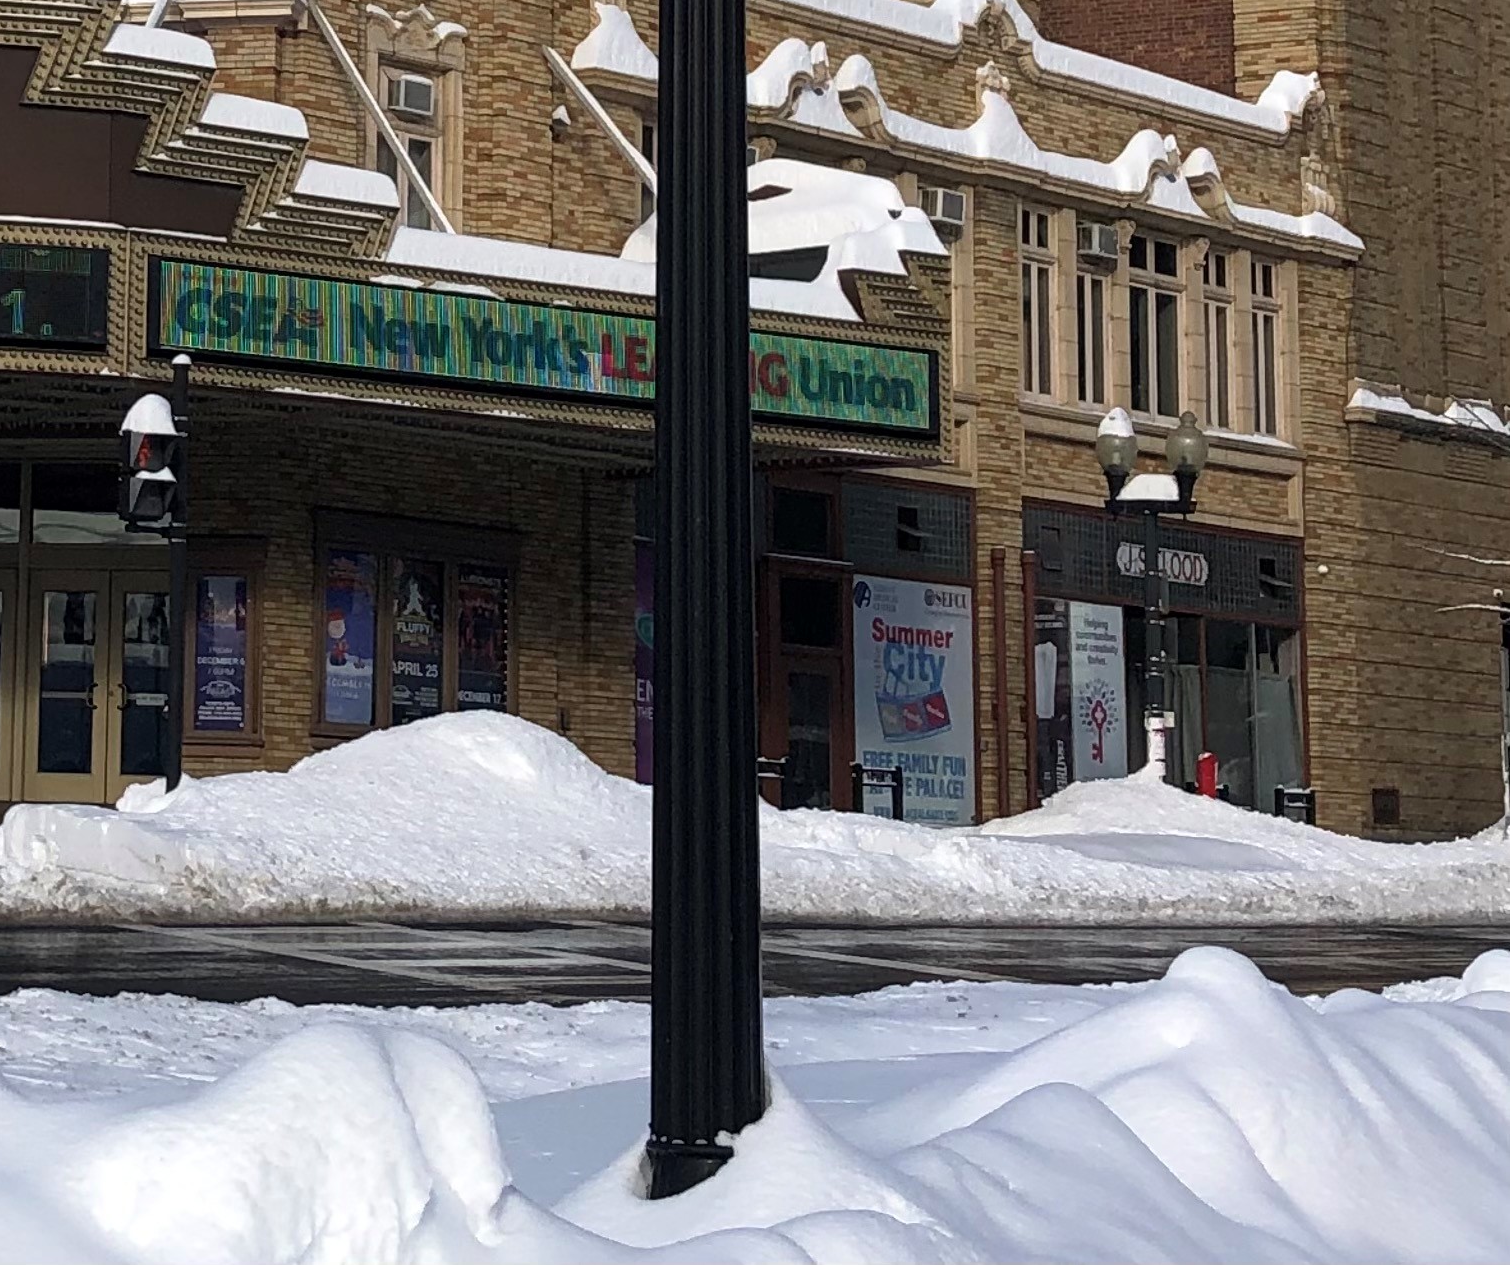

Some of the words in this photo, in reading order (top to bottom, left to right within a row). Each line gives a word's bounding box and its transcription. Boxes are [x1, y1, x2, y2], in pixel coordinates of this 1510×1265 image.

[350, 301, 451, 359] New
[462, 315, 590, 374] York's
[799, 355, 916, 412] Union
[872, 616, 954, 649] Summer
[197, 656, 239, 665] DECEMBER
[883, 642, 946, 691] City
[862, 750, 893, 768] FREE
[897, 752, 940, 774] FAMILY
[942, 755, 967, 777] FUN
